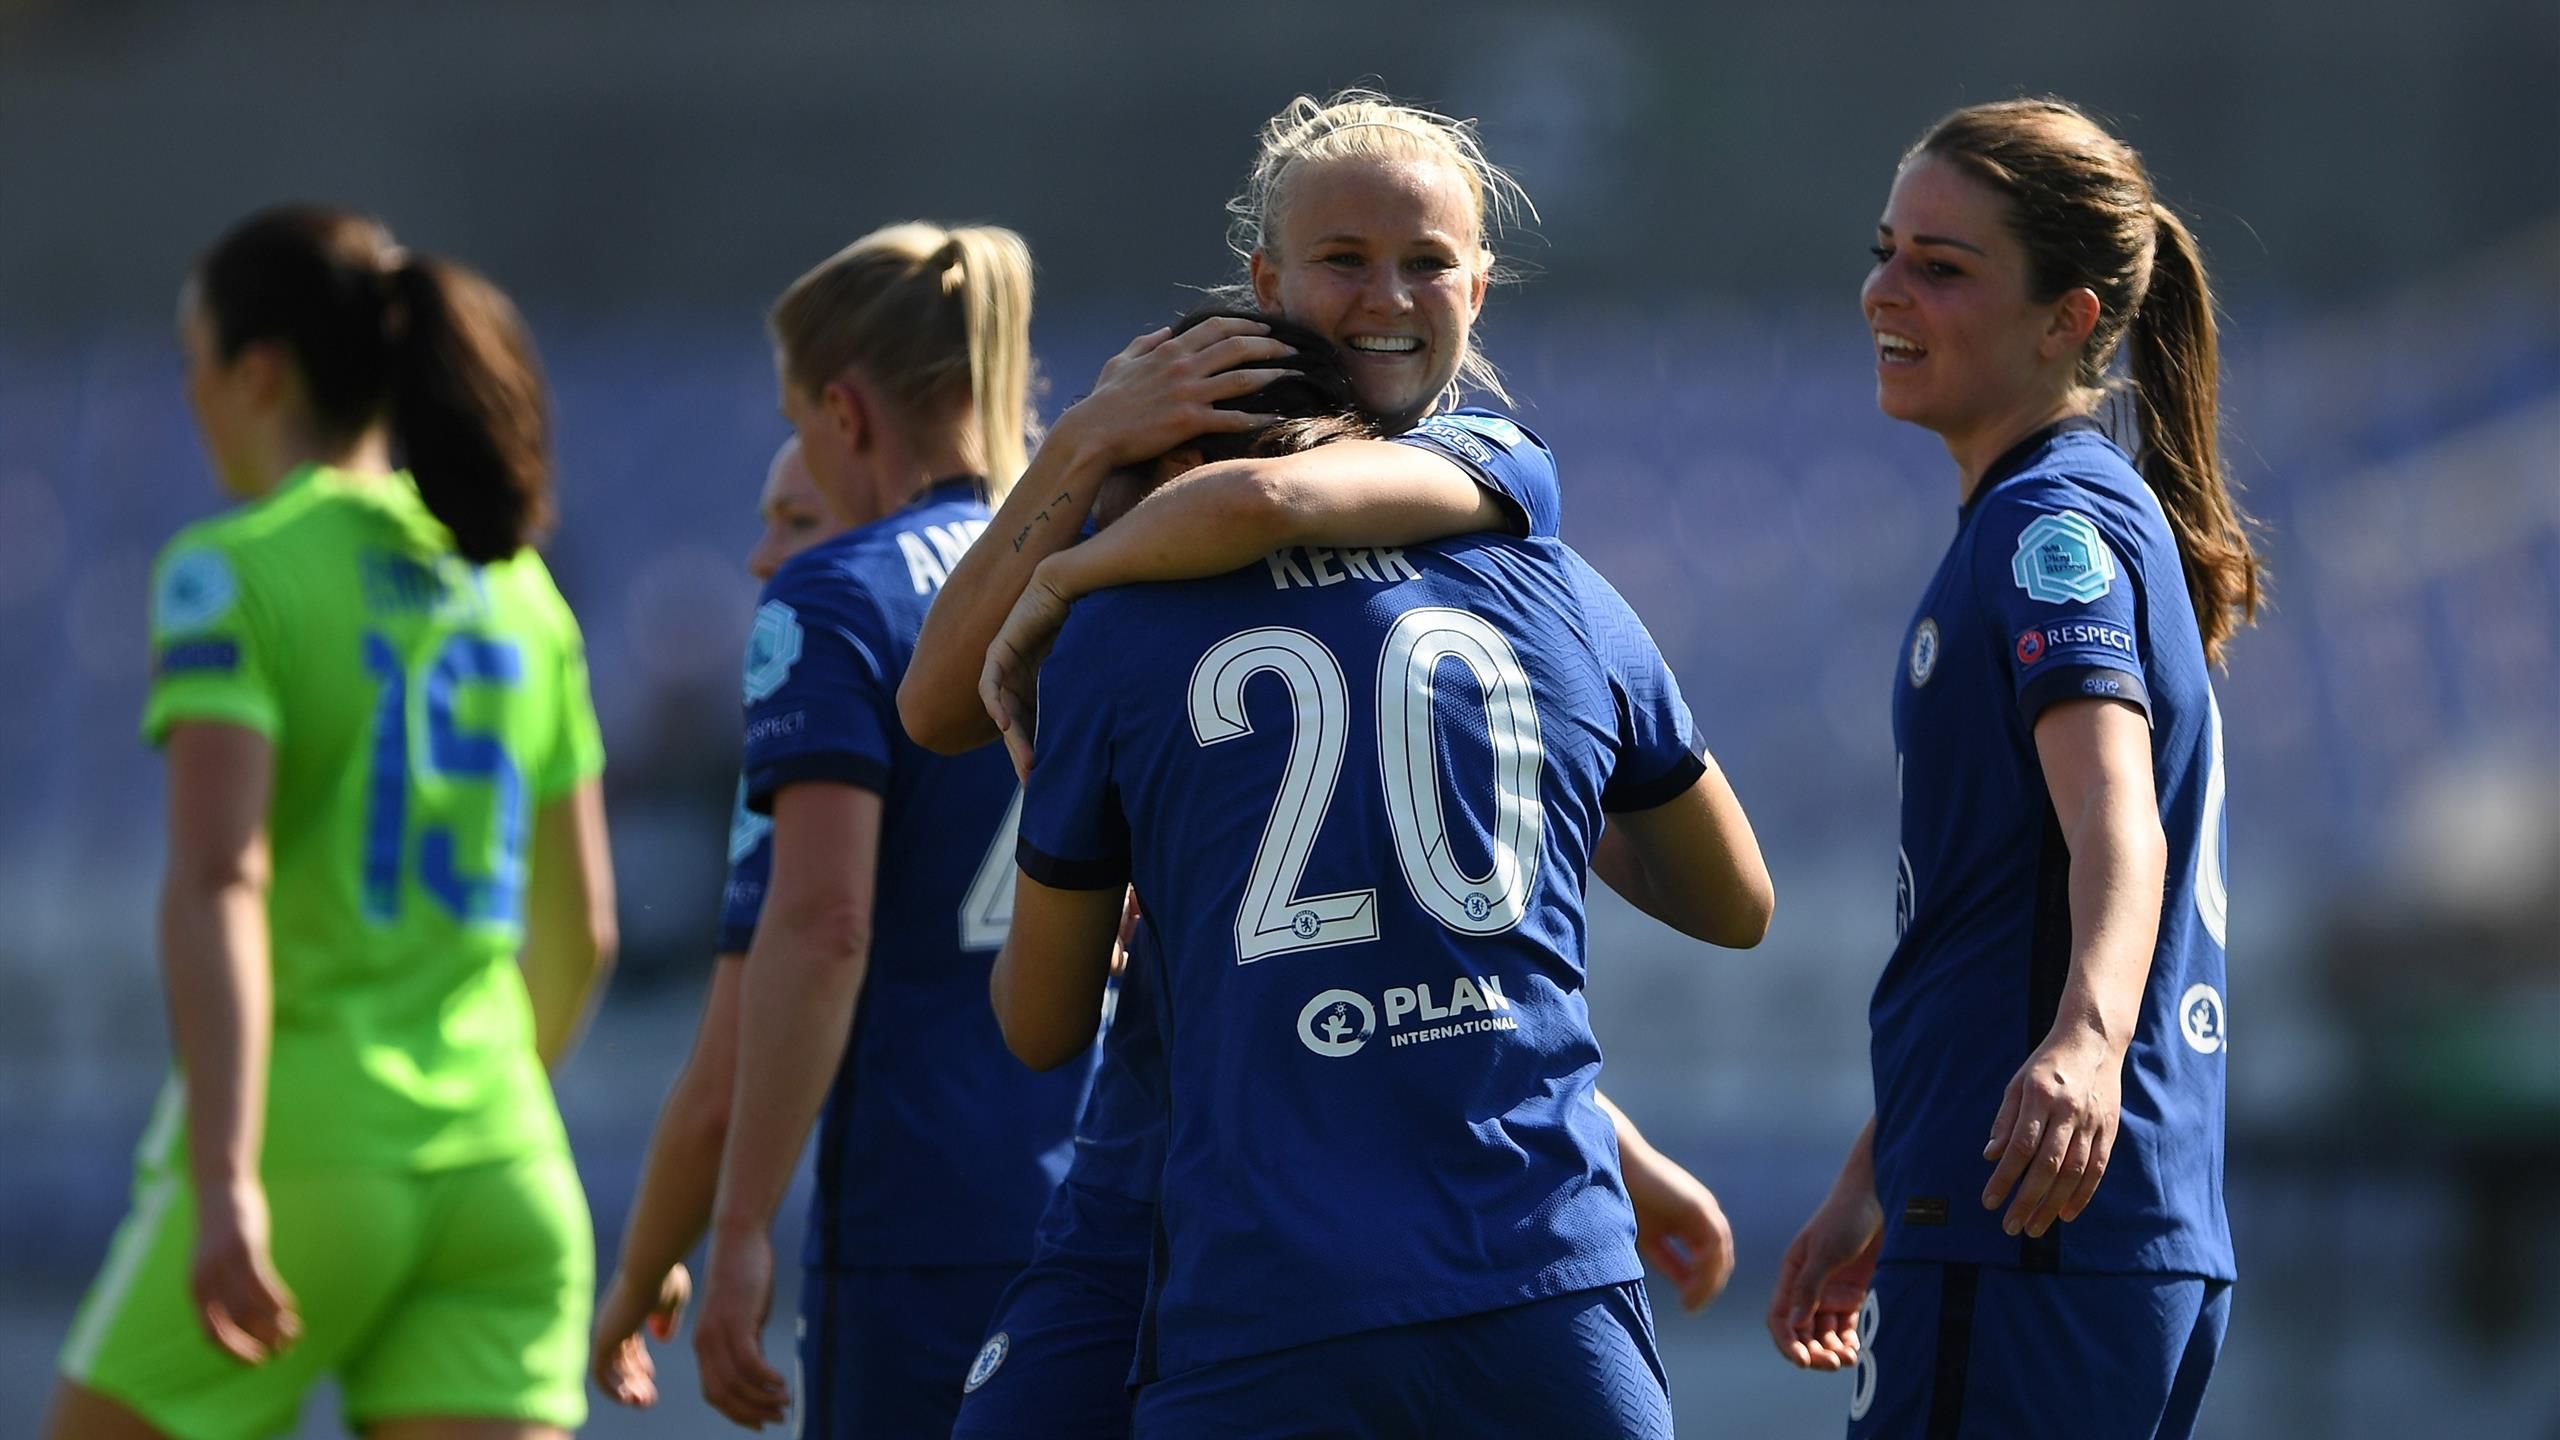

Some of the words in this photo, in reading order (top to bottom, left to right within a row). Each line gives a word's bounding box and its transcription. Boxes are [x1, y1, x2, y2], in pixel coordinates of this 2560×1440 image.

[2047, 624, 2132, 653] RESPECT
[360, 628, 526, 926] 15
[1188, 606, 1545, 966] 20
[1383, 975, 1510, 1027] PLAN
[1390, 1016, 1519, 1048] INTERNATIONAL
